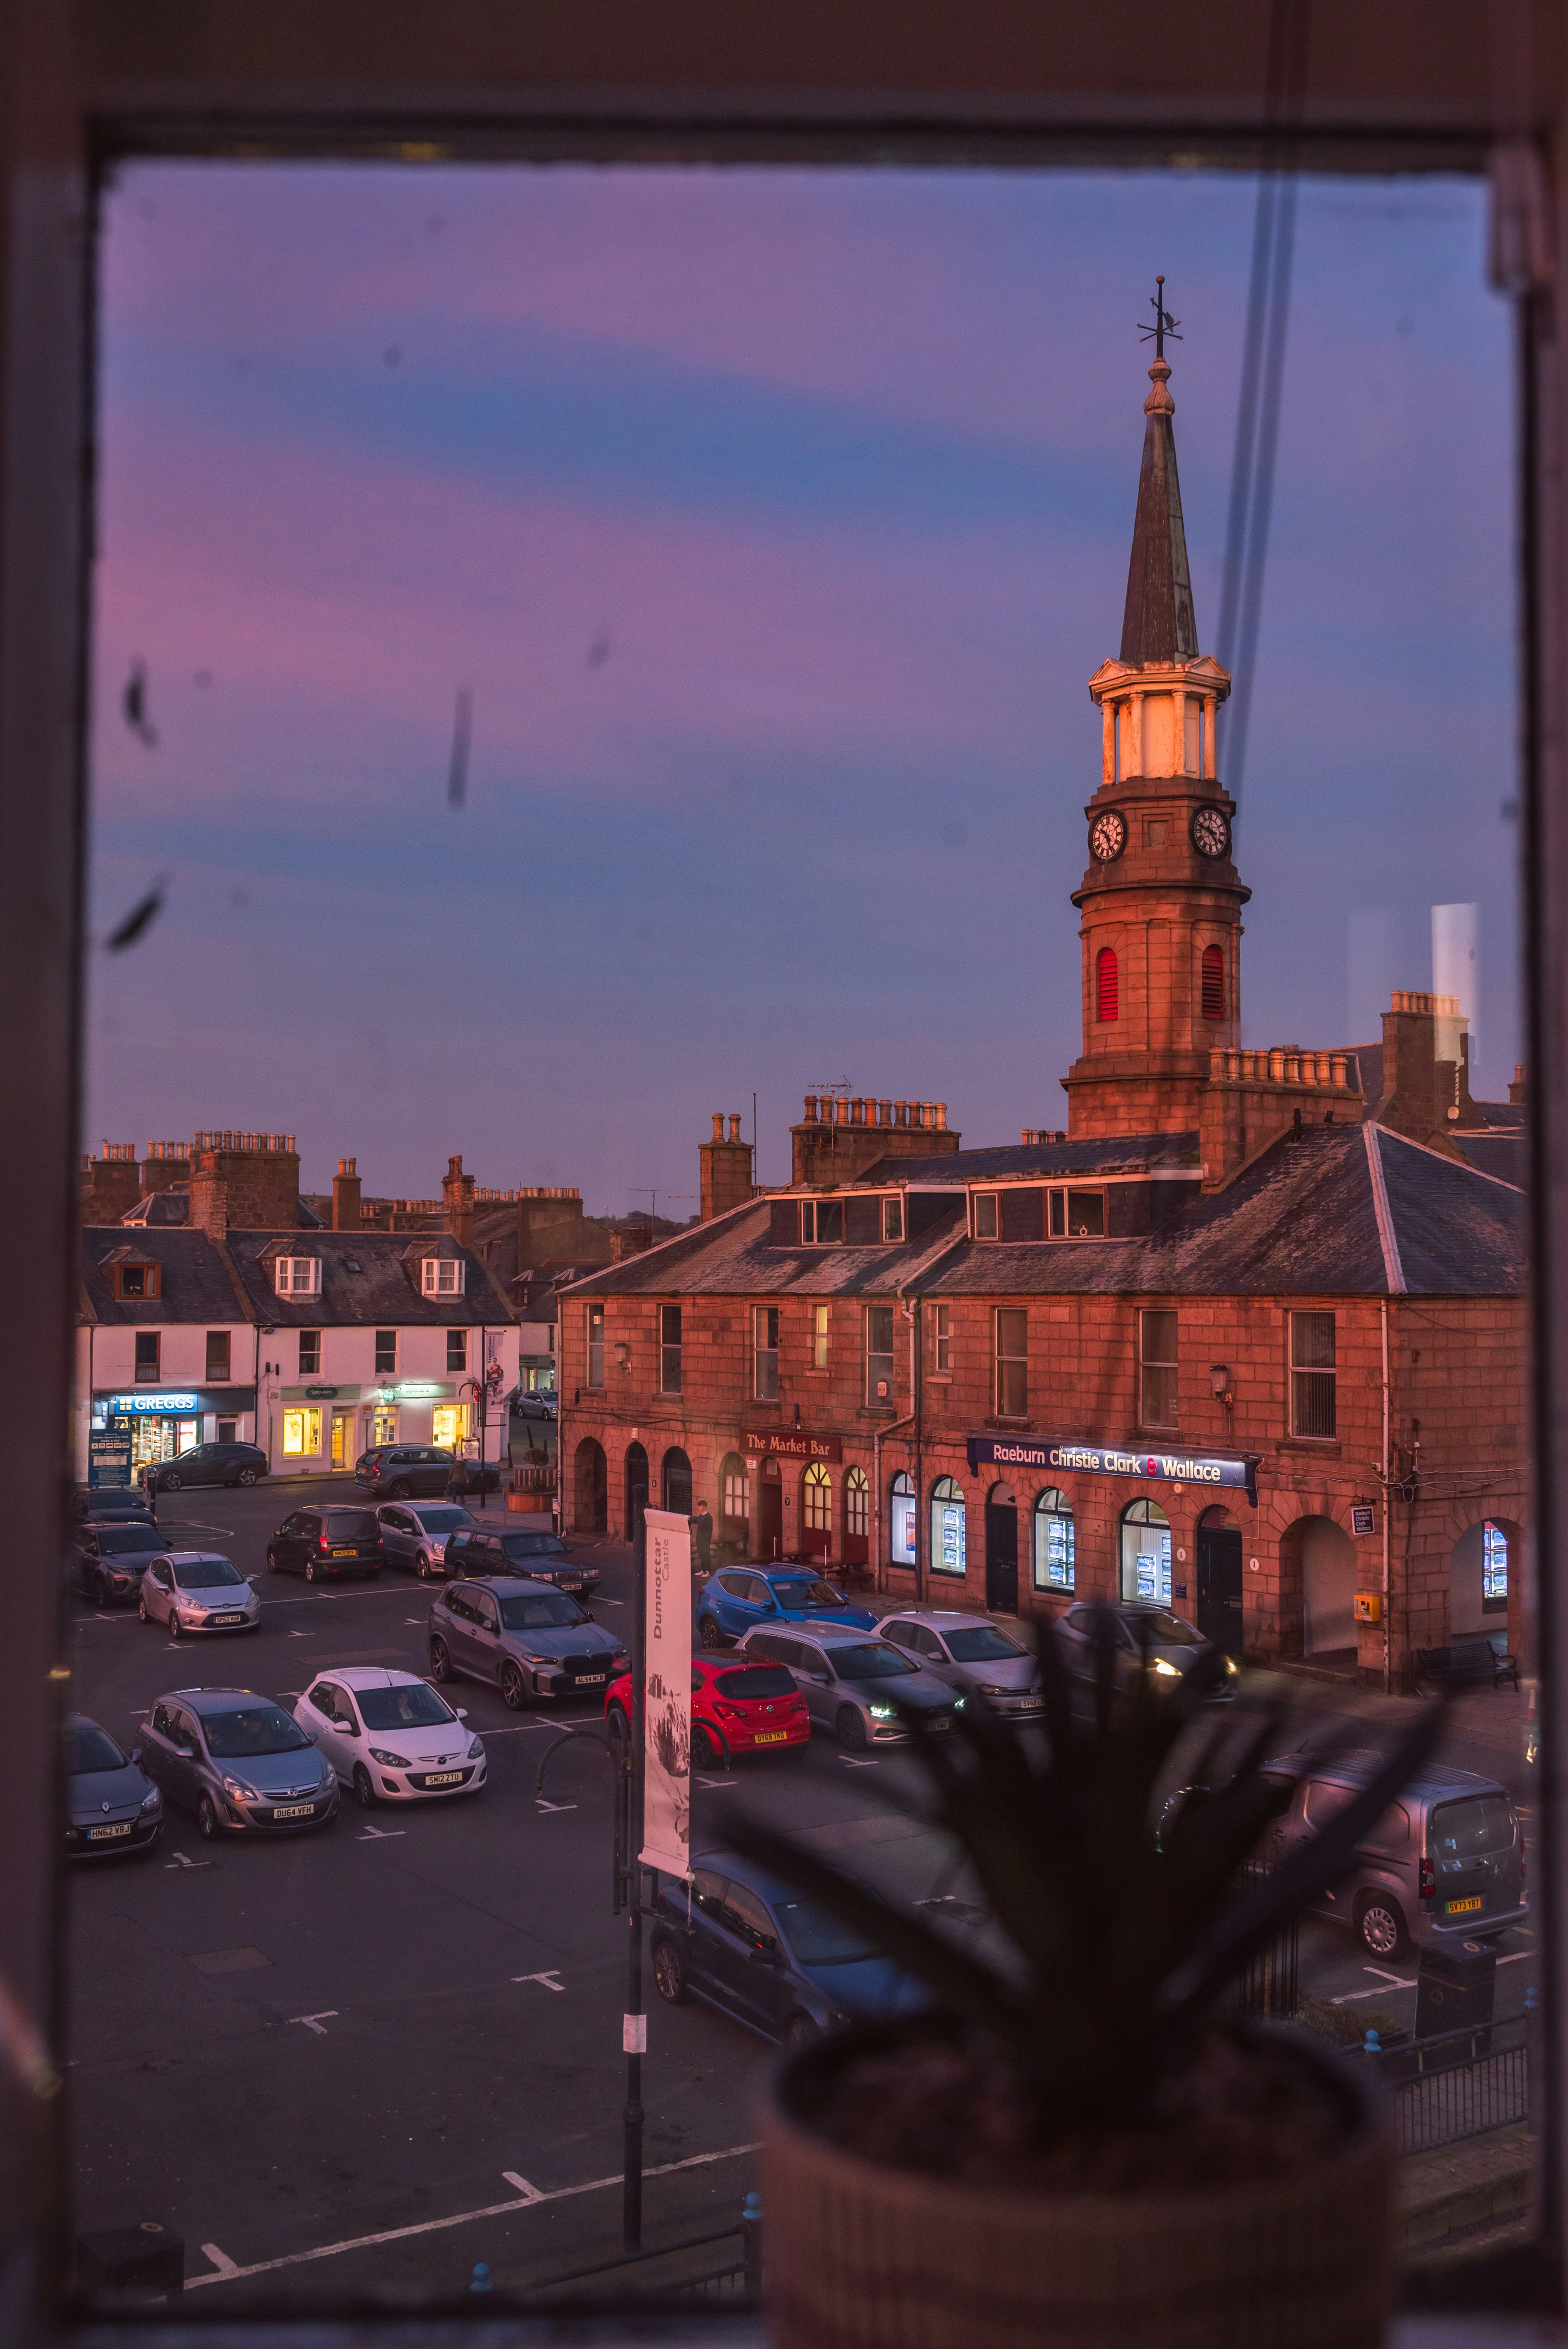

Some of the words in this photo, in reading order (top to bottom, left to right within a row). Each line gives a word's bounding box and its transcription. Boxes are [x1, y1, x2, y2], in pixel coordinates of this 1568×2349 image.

[135, 1397, 194, 1410] GREGGS
[747, 1434, 766, 1449] The
[769, 1436, 807, 1454] Market
[810, 1440, 830, 1455] Bar
[994, 1444, 1045, 1464] Raeburn
[1050, 1449, 1099, 1469] Christie
[1104, 1454, 1141, 1474] Clark
[1147, 1457, 1157, 1475] &
[1162, 1459, 1221, 1481] Wallace
[277, 1809, 295, 1817] DU64
[298, 1806, 311, 1814] VFH
[92, 1828, 113, 1837] HN62
[115, 1825, 129, 1834] VRJ
[1449, 1901, 1466, 1911] SV73
[1467, 1899, 1479, 1908] YBT
